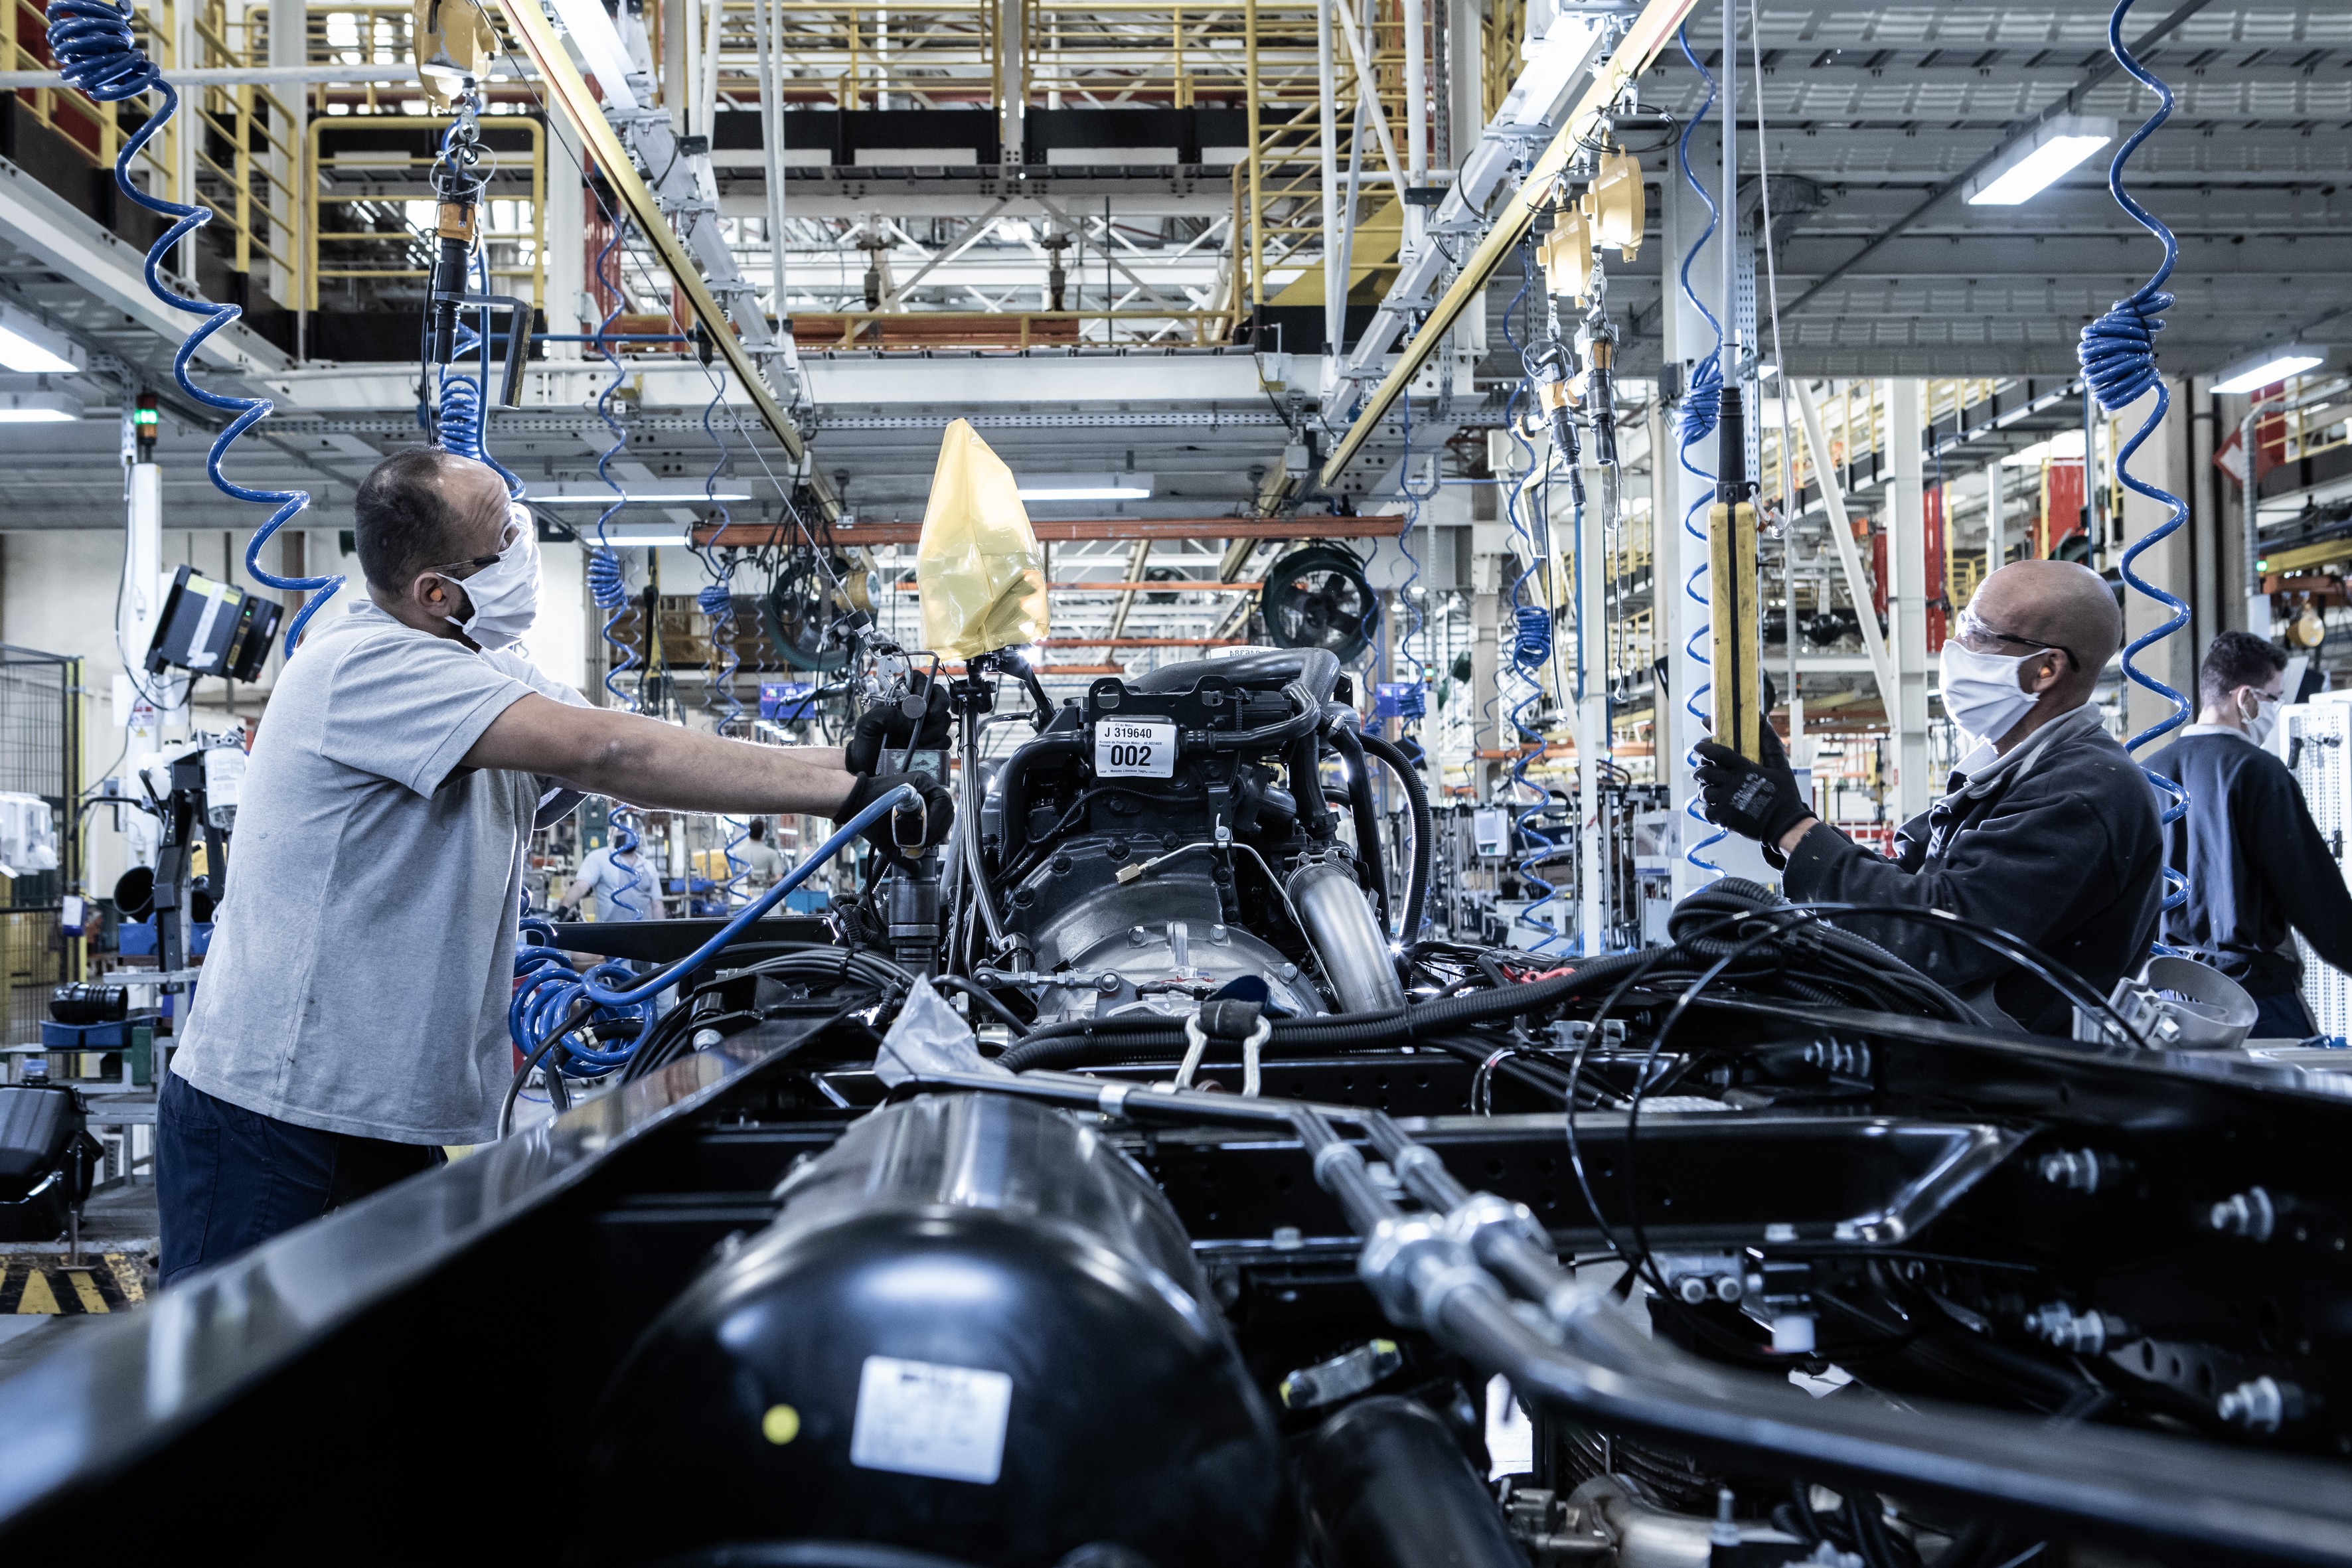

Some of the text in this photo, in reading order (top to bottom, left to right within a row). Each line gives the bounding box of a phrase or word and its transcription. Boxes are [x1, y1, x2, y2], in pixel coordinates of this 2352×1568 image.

[1105, 727, 1152, 738] J 319640
[1111, 745, 1152, 767] 002
